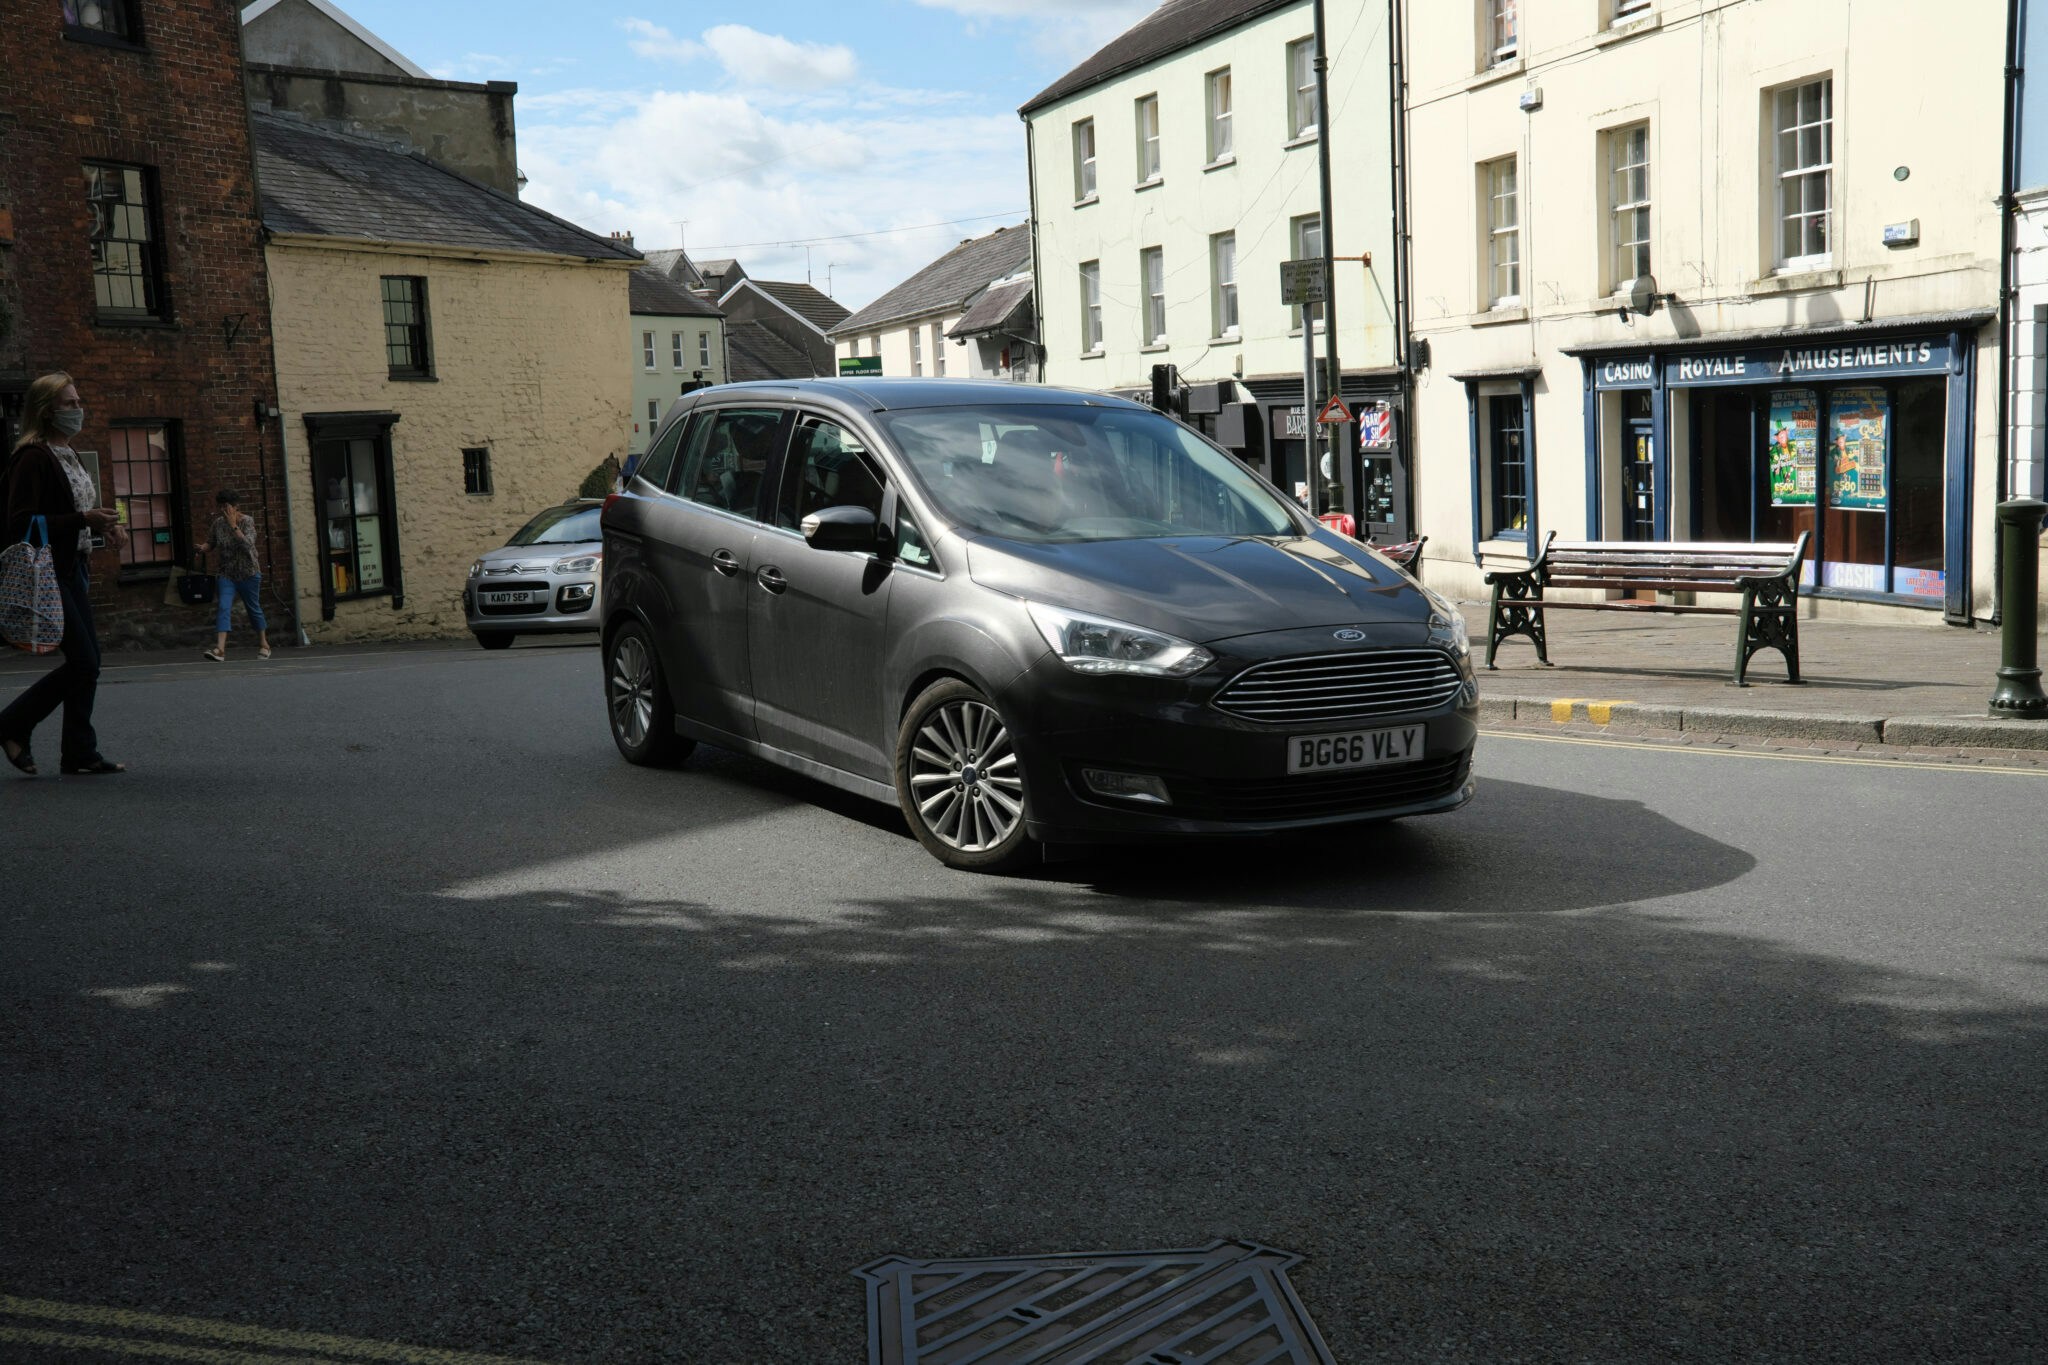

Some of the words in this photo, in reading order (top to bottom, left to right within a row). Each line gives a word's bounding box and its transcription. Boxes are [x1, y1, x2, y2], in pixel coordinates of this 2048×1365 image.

[1604, 361, 1652, 383] CASINO
[1679, 356, 1746, 380] ROYALE
[1777, 342, 1931, 375] AMUSEMENTS
[1774, 482, 1794, 492] £500
[1834, 481, 1856, 492] £500
[1835, 564, 1874, 588] CASH
[490, 593, 511, 603] KA07
[513, 592, 528, 602] SEP
[1298, 734, 1364, 768] BG66
[1371, 728, 1416, 760] VLY
